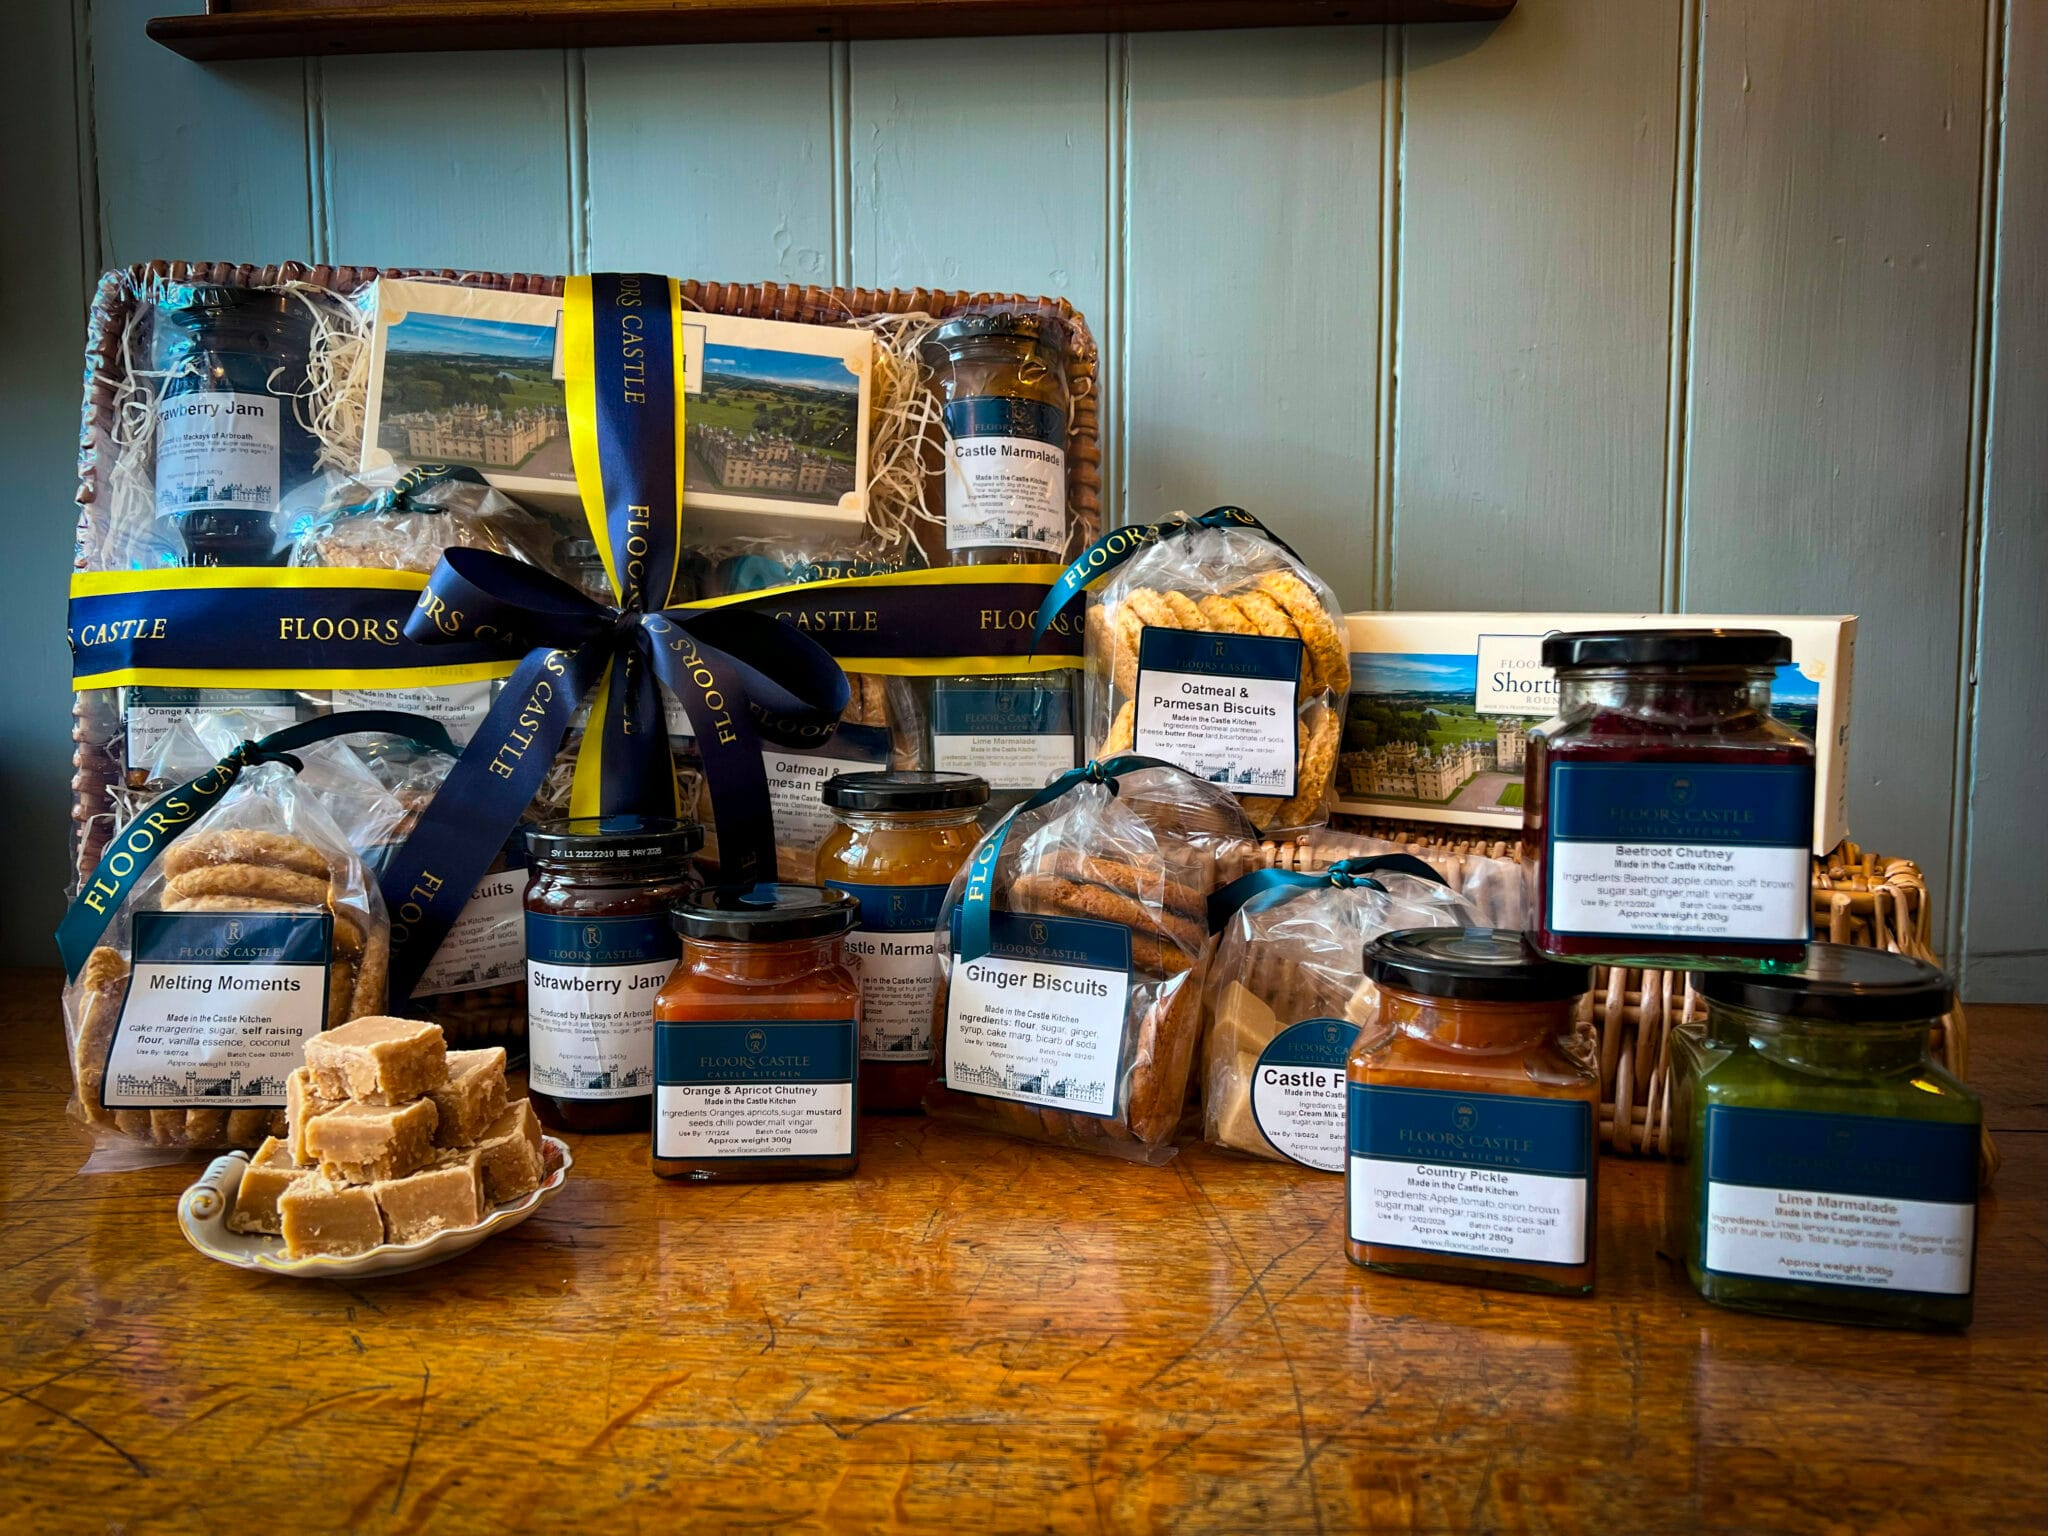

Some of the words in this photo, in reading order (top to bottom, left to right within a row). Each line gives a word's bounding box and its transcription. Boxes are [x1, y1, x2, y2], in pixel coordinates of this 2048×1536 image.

[621, 315, 645, 404] CASTLE
[226, 401, 264, 417] Jam
[955, 445, 997, 458] Castle
[1001, 445, 1060, 466] Marmalade
[81, 618, 168, 647] CASTLE
[279, 617, 399, 646] FLOORS
[670, 637, 738, 746] FLOORS
[1181, 682, 1236, 698] Oatmeal
[1239, 687, 1249, 698] &
[1153, 696, 1219, 712] Parmesan
[1223, 702, 1276, 716] Biscuits
[1210, 716, 1231, 724] Castle
[489, 681, 553, 780] CASTLE
[993, 737, 1036, 745] Marmalade
[776, 761, 829, 777] Oatmeal
[84, 796, 197, 915] FLOORS
[1615, 845, 1672, 857] Beetroot
[1676, 847, 1735, 861] Chutney
[1614, 860, 1638, 868] Made
[1640, 860, 1649, 868] in
[1651, 861, 1666, 869] the
[1668, 861, 1696, 870] Castle
[1698, 862, 1734, 872] Kitchen
[471, 882, 514, 900] cuits
[1661, 910, 1699, 921] weight
[179, 947, 230, 958] FLOORS
[233, 947, 281, 957] CASTLE
[150, 974, 213, 993] Melting
[218, 975, 301, 992] Moments
[534, 971, 622, 995] Strawberry
[628, 975, 666, 990] Jam
[966, 964, 1028, 989] Ginger
[1033, 972, 1109, 998] Biscuits
[166, 1013, 189, 1022] Made
[190, 1013, 198, 1022] in
[199, 1014, 211, 1023] the
[212, 1014, 238, 1023] Castle
[239, 1015, 272, 1023] Kitchen
[540, 1007, 568, 1019] Produced
[570, 1012, 578, 1020] by
[580, 1012, 612, 1020] Mackays
[985, 1004, 1005, 1014] Made
[1006, 1007, 1013, 1015] in
[1014, 1009, 1026, 1017] the
[1027, 1009, 1050, 1020] Castle
[1051, 1013, 1079, 1024] Kitchen
[129, 1024, 153, 1032] cake
[242, 1026, 262, 1035] self
[265, 1026, 303, 1037] raising
[986, 1028, 1007, 1038] cake
[1036, 1033, 1063, 1045] bicarb
[1065, 1038, 1074, 1046] of
[1075, 1040, 1097, 1050] soda
[168, 1037, 200, 1046] vanilla
[249, 1039, 291, 1047] coconut
[700, 1055, 756, 1069] FLOORS
[759, 1055, 811, 1067] CASTLE
[1264, 1069, 1327, 1088] Castle
[682, 1087, 721, 1097] Orange
[723, 1086, 731, 1095] &
[734, 1086, 772, 1096] Apricot
[774, 1086, 818, 1096] Chutney
[1284, 1089, 1303, 1097] Made
[1304, 1089, 1311, 1097] in
[1312, 1089, 1324, 1097] the
[806, 1108, 842, 1116] mustard
[707, 1137, 739, 1145] Approx
[740, 1137, 769, 1145] weight
[771, 1136, 792, 1144] 300g
[1400, 1129, 1465, 1149] FLOORS
[1469, 1134, 1534, 1152] CASTLE
[1416, 1165, 1467, 1181] Country
[1470, 1170, 1509, 1184] Pickle
[1407, 1177, 1431, 1187] Made
[1432, 1179, 1440, 1188] in
[1441, 1180, 1456, 1189] the
[1457, 1183, 1483, 1193] Castle
[1485, 1185, 1519, 1197] Kitchen
[1777, 1193, 1813, 1206] Lime
[1817, 1196, 1898, 1215] Marmalade
[1813, 1210, 1829, 1220] the
[1411, 1224, 1449, 1237] Approx
[1451, 1228, 1486, 1240] weight
[1488, 1231, 1514, 1244] 280g
